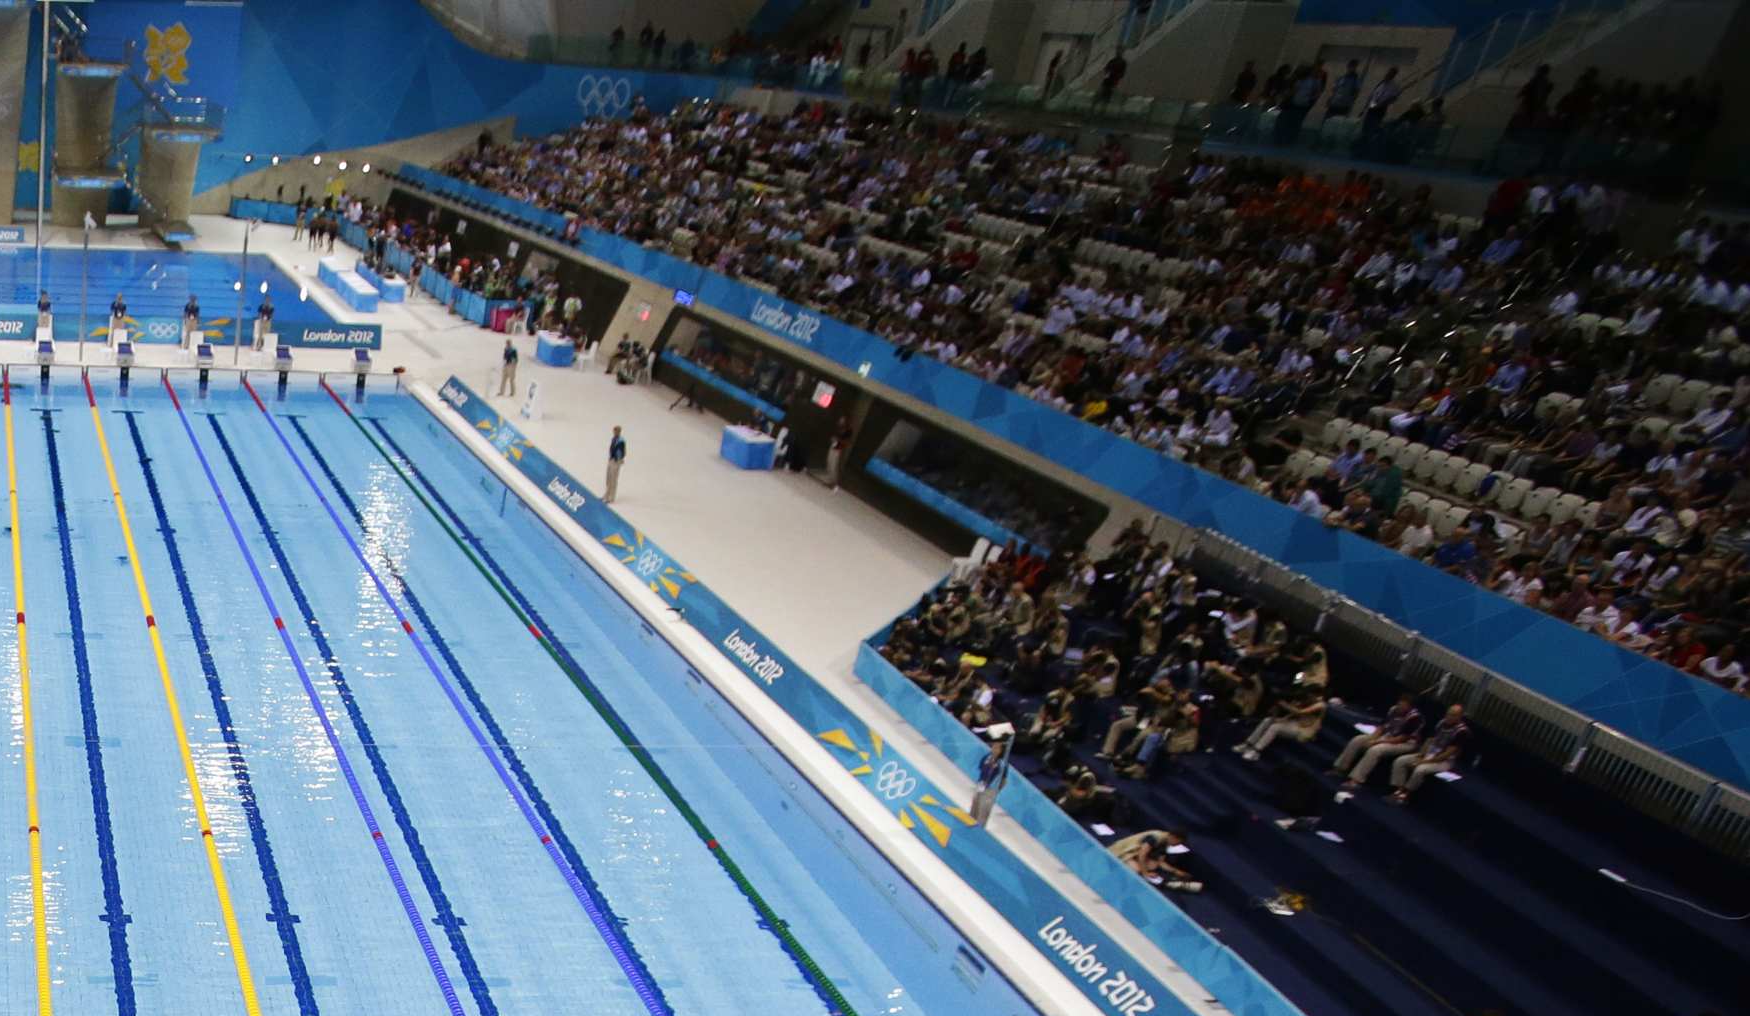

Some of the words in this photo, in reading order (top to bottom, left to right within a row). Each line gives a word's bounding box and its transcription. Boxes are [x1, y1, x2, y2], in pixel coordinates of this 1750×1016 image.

[0, 230, 19, 240] 2012
[751, 295, 792, 330] London
[303, 328, 345, 342] London
[346, 330, 374, 344] 2012
[723, 628, 761, 667] London
[754, 655, 785, 686] 2012
[1038, 916, 1108, 984] London
